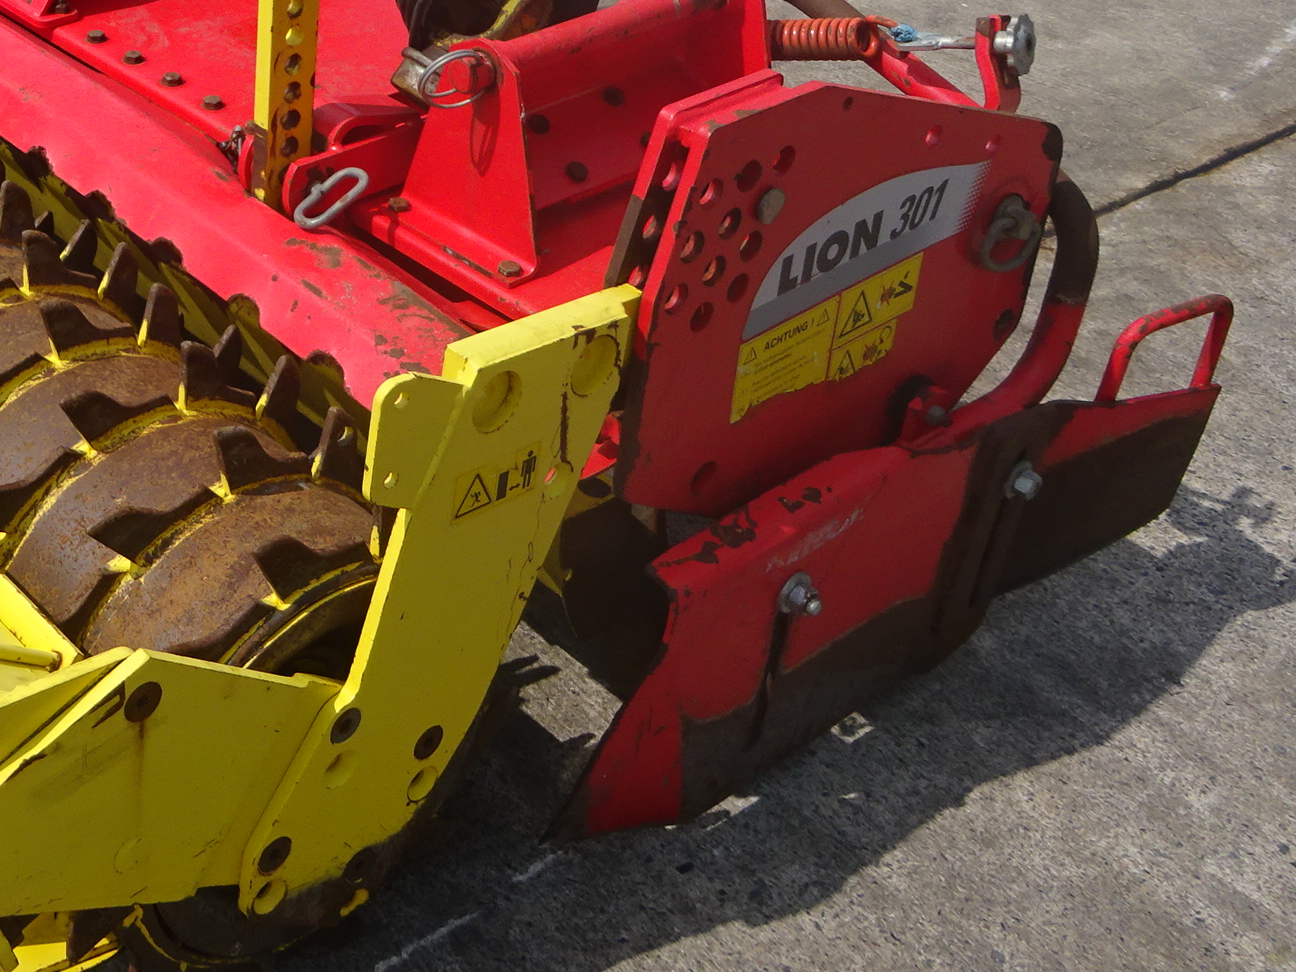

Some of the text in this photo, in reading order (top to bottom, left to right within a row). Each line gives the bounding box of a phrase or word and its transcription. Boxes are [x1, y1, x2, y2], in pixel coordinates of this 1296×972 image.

[777, 178, 950, 296] LION 301
[763, 320, 808, 352] ACHTUNG
